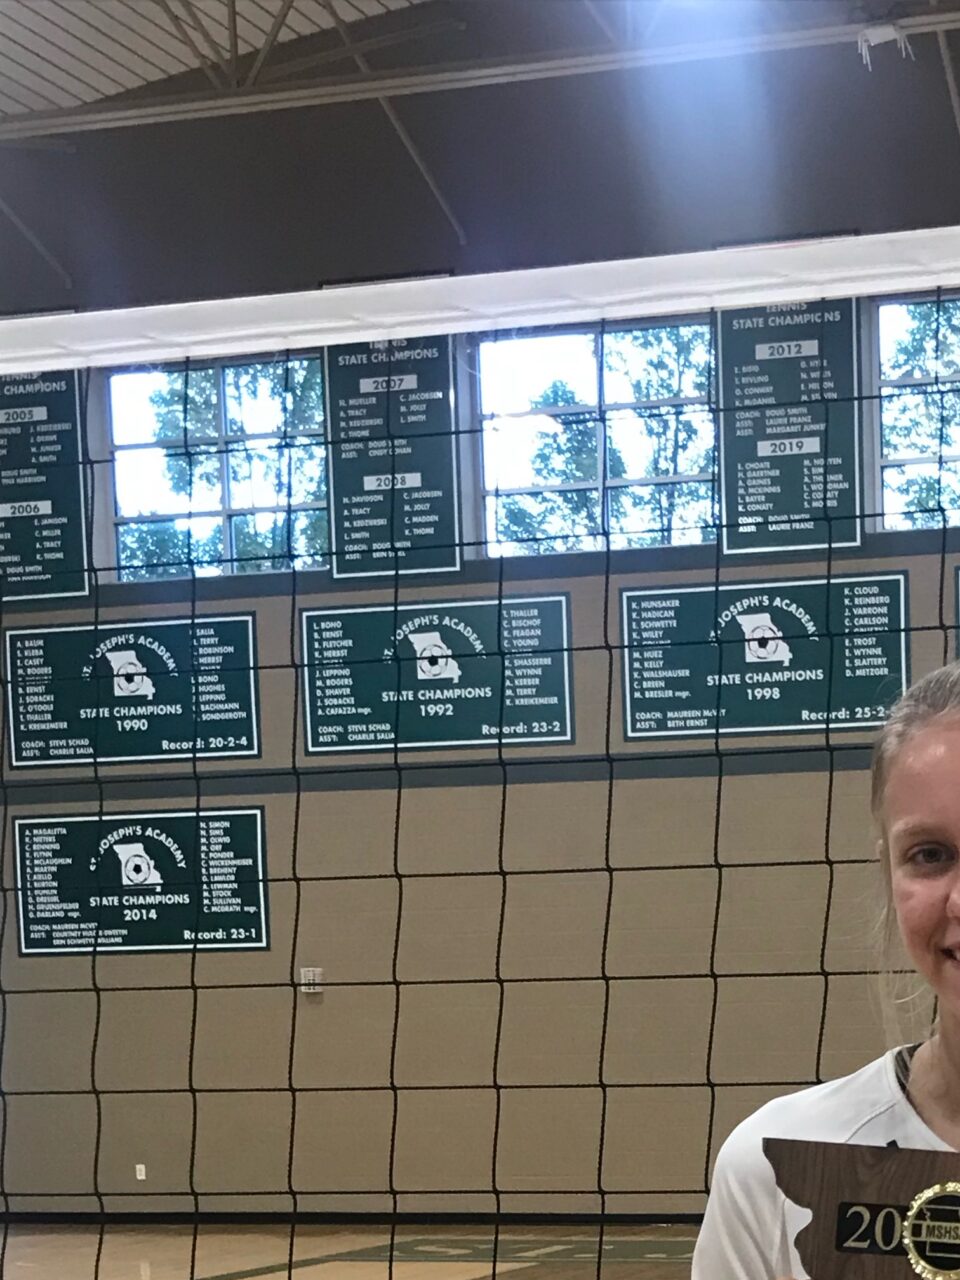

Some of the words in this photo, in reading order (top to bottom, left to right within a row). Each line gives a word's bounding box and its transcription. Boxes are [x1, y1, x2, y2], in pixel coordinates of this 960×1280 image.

[733, 318, 764, 329] STATE
[768, 344, 802, 356] 2012
[339, 354, 367, 365] STATE
[4, 381, 67, 395] CHAMPIONS
[373, 379, 404, 390] 2007
[4, 410, 34, 421] 2005
[770, 441, 804, 453] 2019
[376, 476, 406, 487] 2008
[10, 505, 40, 515] 2006
[718, 596, 769, 627] JOSEPH'S
[90, 634, 134, 659] OSEPH'S
[707, 674, 740, 686] STATE
[745, 669, 823, 684] CHAMPIONS
[418, 687, 492, 700] CHAMPIONS
[747, 687, 780, 700] 1998
[114, 705, 182, 717] CHAMPIONS
[420, 704, 453, 716] 1992
[117, 719, 148, 731] 1990
[532, 722, 561, 732] 23-2
[209, 737, 248, 748] 20-2-4
[99, 826, 142, 855] JOSEPH'S
[145, 828, 186, 868] ACADEMY
[90, 896, 119, 906] STATE
[123, 895, 190, 905] CHAMPIONS
[124, 909, 157, 920] 2014
[231, 929, 256, 938] 23-1
[843, 1206, 901, 1250] 20
